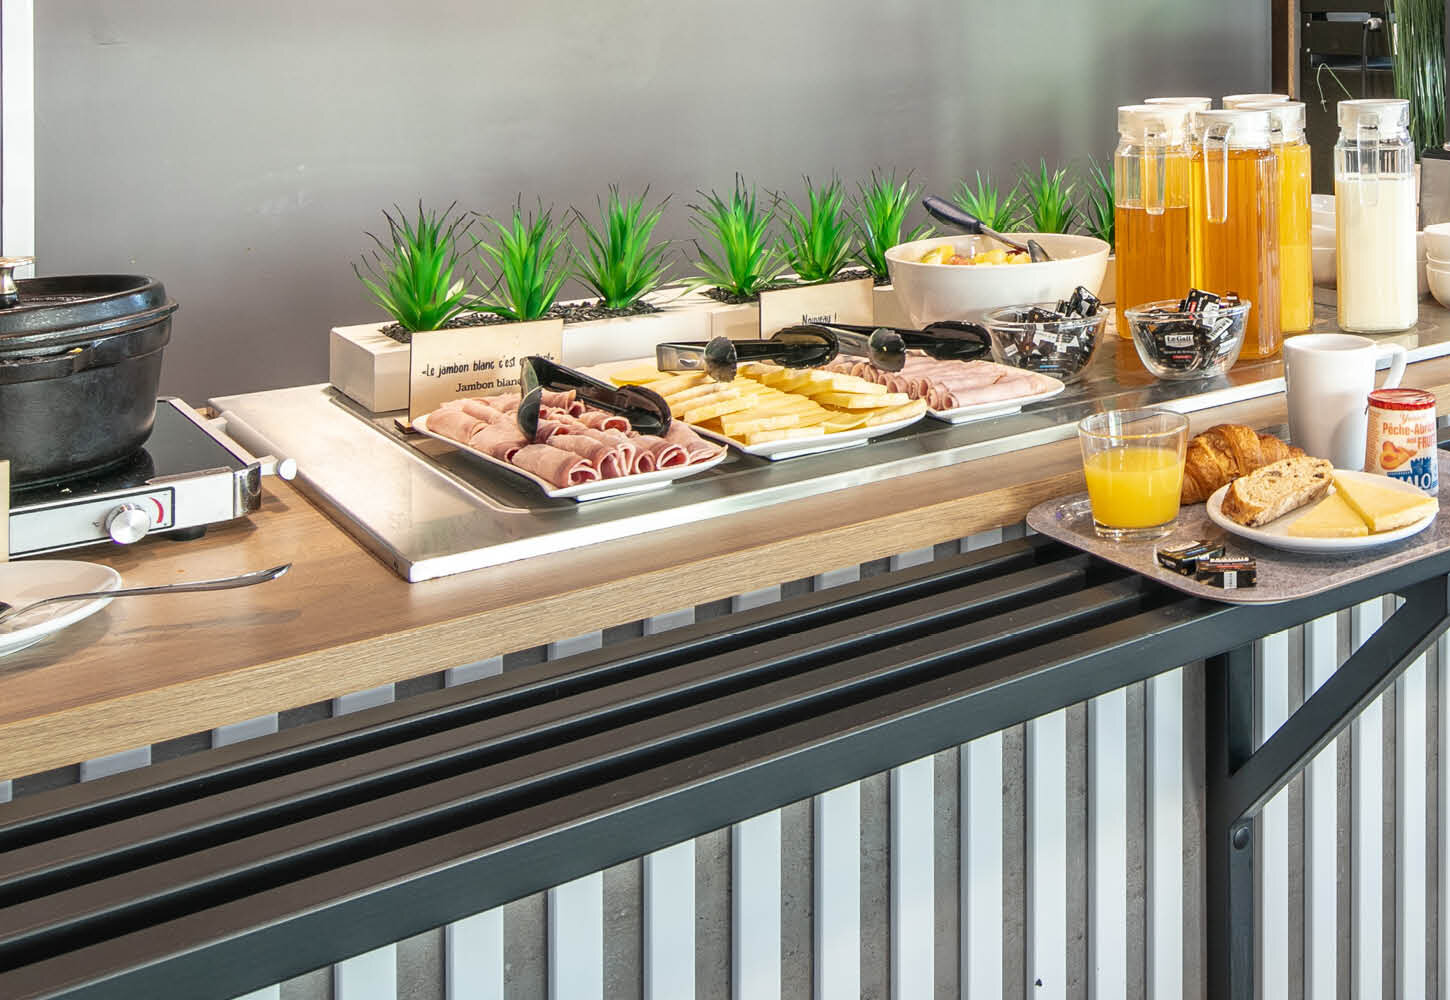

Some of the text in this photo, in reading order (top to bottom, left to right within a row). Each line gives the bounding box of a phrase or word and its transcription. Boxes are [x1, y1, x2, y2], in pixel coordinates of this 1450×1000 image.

[439, 361, 469, 378] jambon
[473, 359, 495, 372] blanc
[455, 381, 494, 393] Jambon
